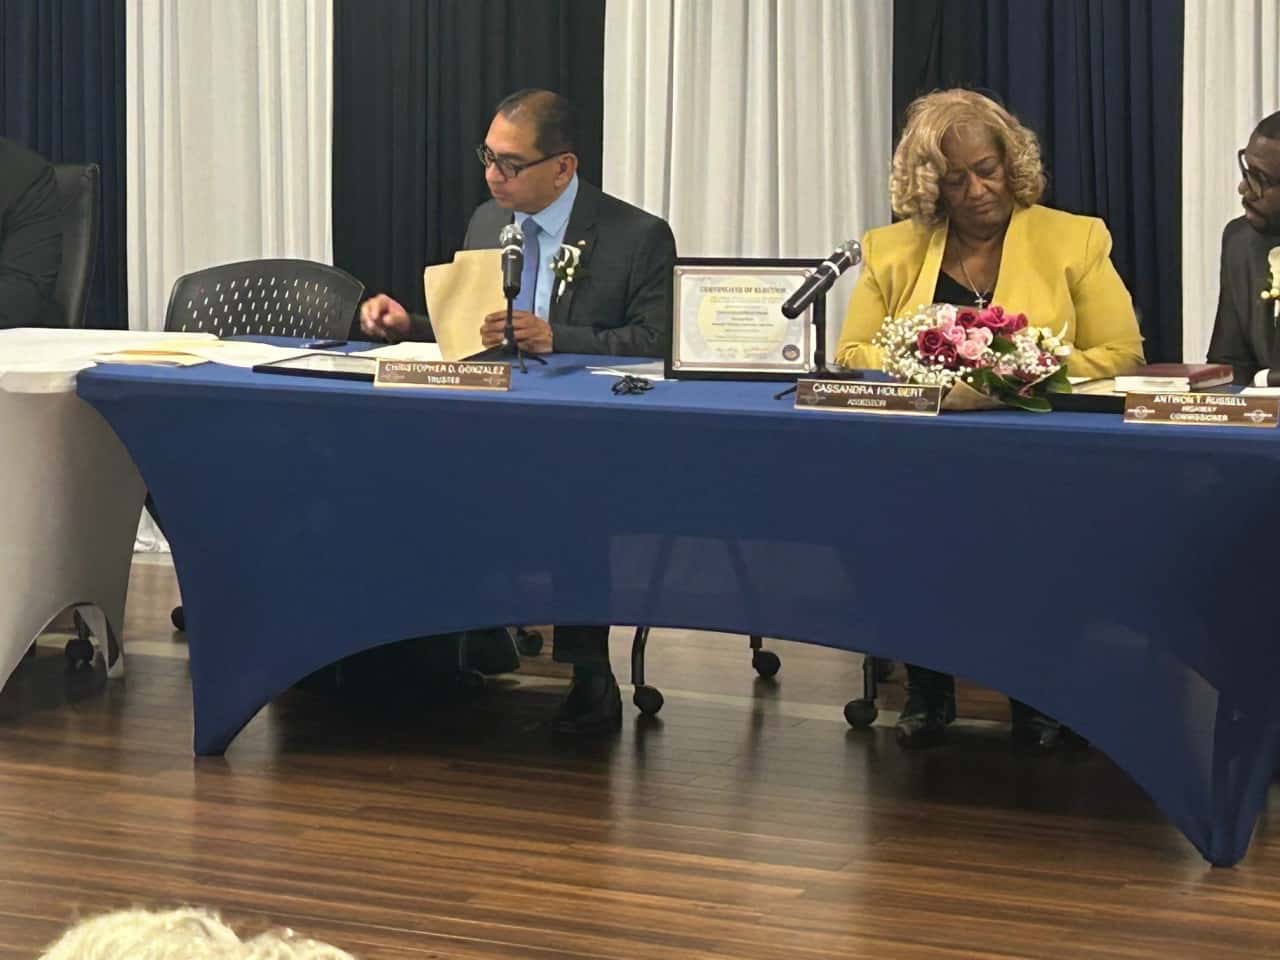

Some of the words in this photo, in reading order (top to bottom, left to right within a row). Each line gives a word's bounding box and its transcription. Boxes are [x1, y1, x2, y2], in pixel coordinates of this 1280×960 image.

[699, 286, 742, 294] CERTIFICATE
[385, 362, 446, 373] CHRISTOPHER
[447, 364, 456, 374] D.
[458, 364, 505, 375] GONZALEZ
[427, 375, 460, 384] TRUSTEE
[812, 382, 874, 395] CASSANDRA
[847, 398, 887, 407] ASSESSOR
[1153, 394, 1194, 405] ANTWON
[1206, 395, 1248, 407] RUSSELL
[1170, 412, 1229, 422] COMMISSIONER
